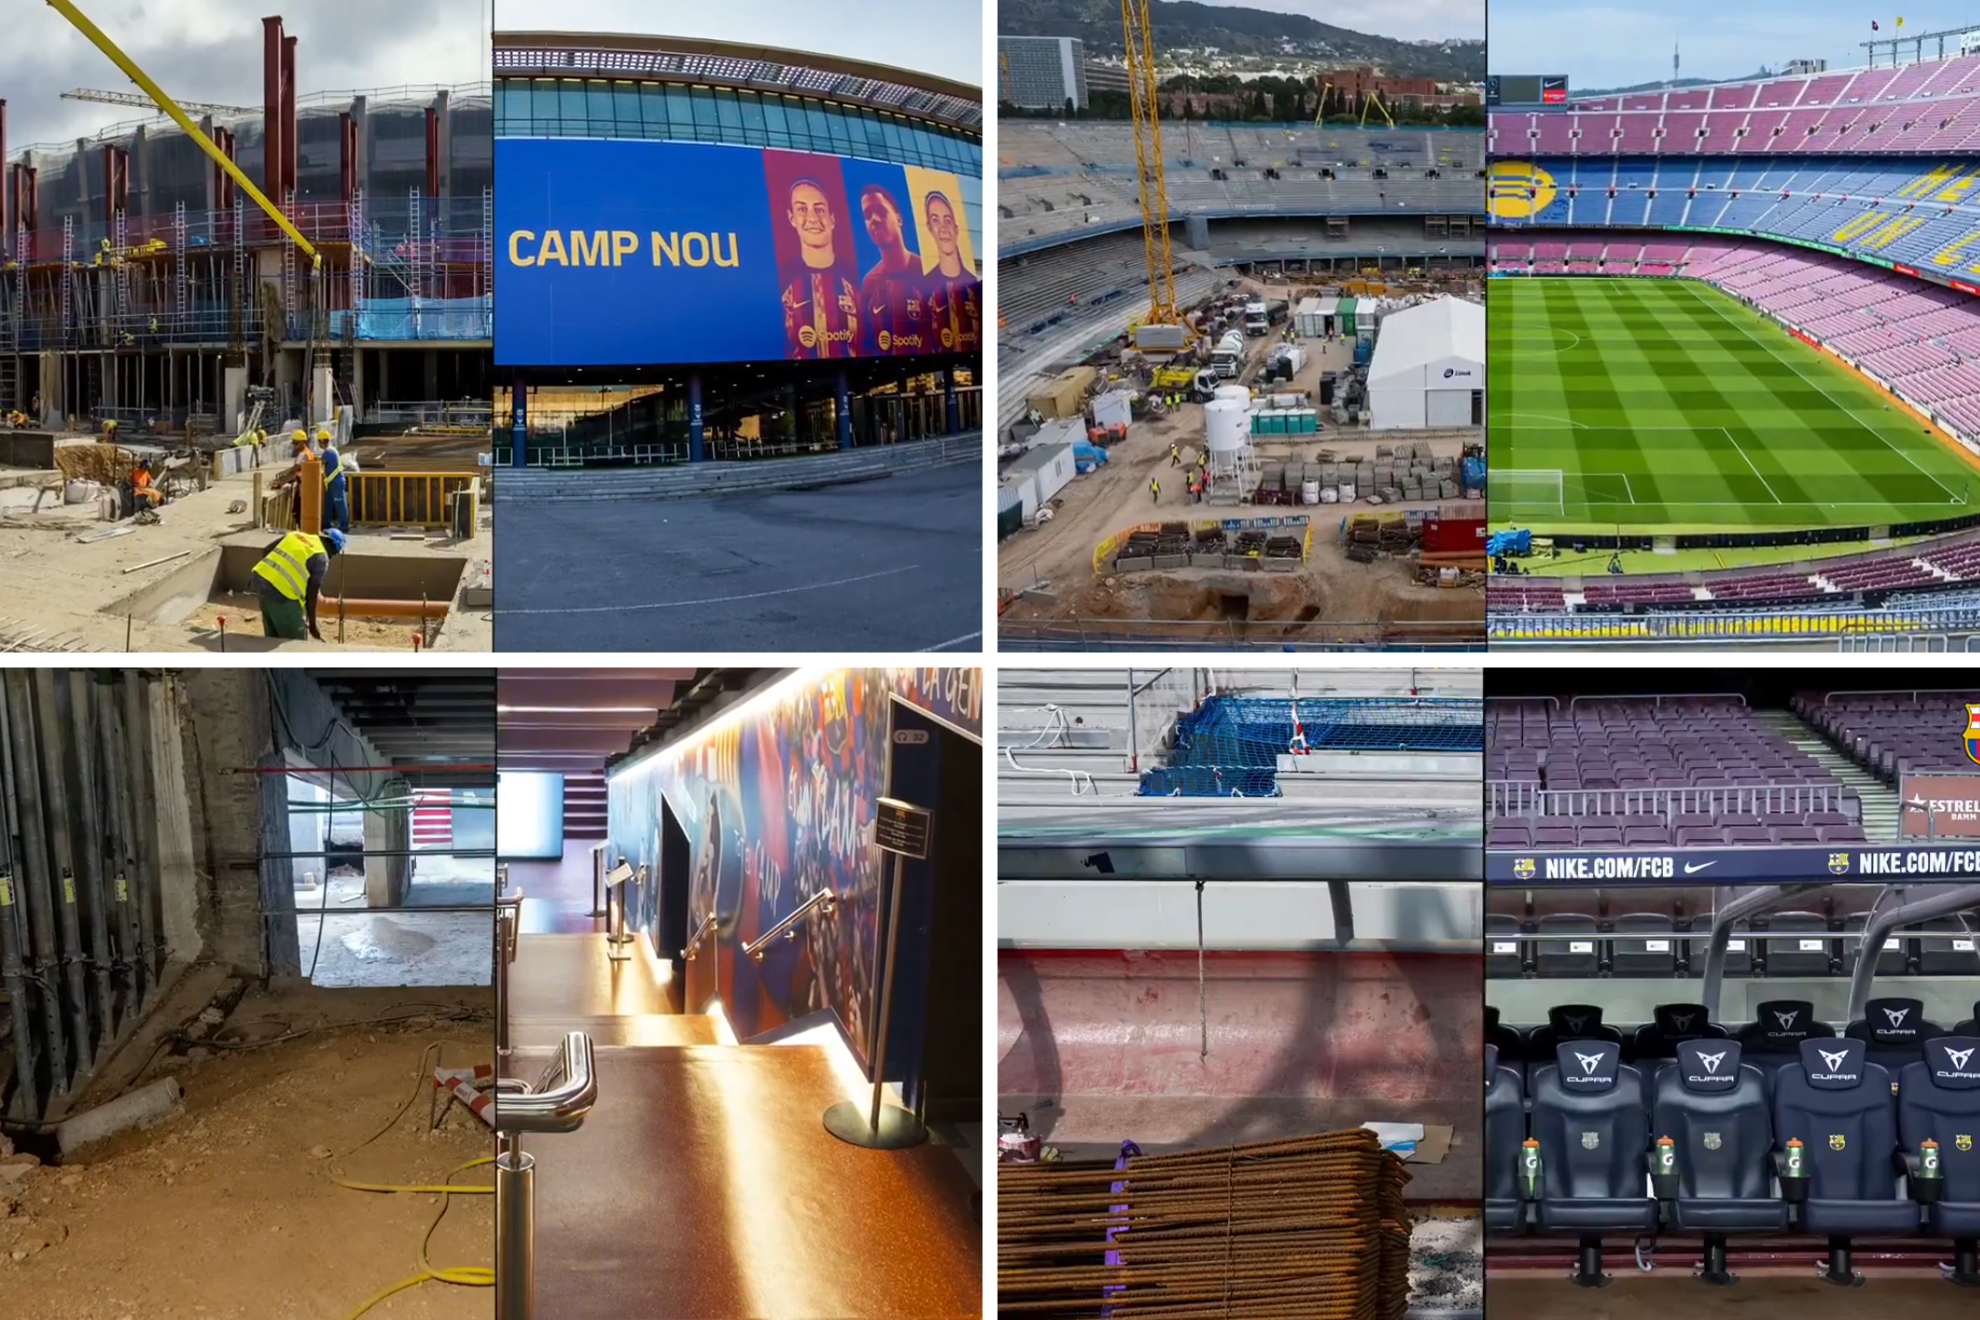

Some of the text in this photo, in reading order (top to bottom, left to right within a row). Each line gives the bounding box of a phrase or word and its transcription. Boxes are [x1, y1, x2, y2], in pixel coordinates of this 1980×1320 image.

[508, 229, 739, 267] CAMP NOU
[818, 329, 853, 342] Spotify
[892, 334, 922, 347] Spotify
[912, 733, 924, 742] 32
[1950, 813, 1977, 821] DAMM
[1545, 857, 1674, 879] NIKE.COM/FCB
[1526, 1156, 1537, 1169] G
[1663, 1153, 1674, 1166] G
[1788, 1156, 1800, 1169] G
[1925, 1156, 1937, 1169] G
